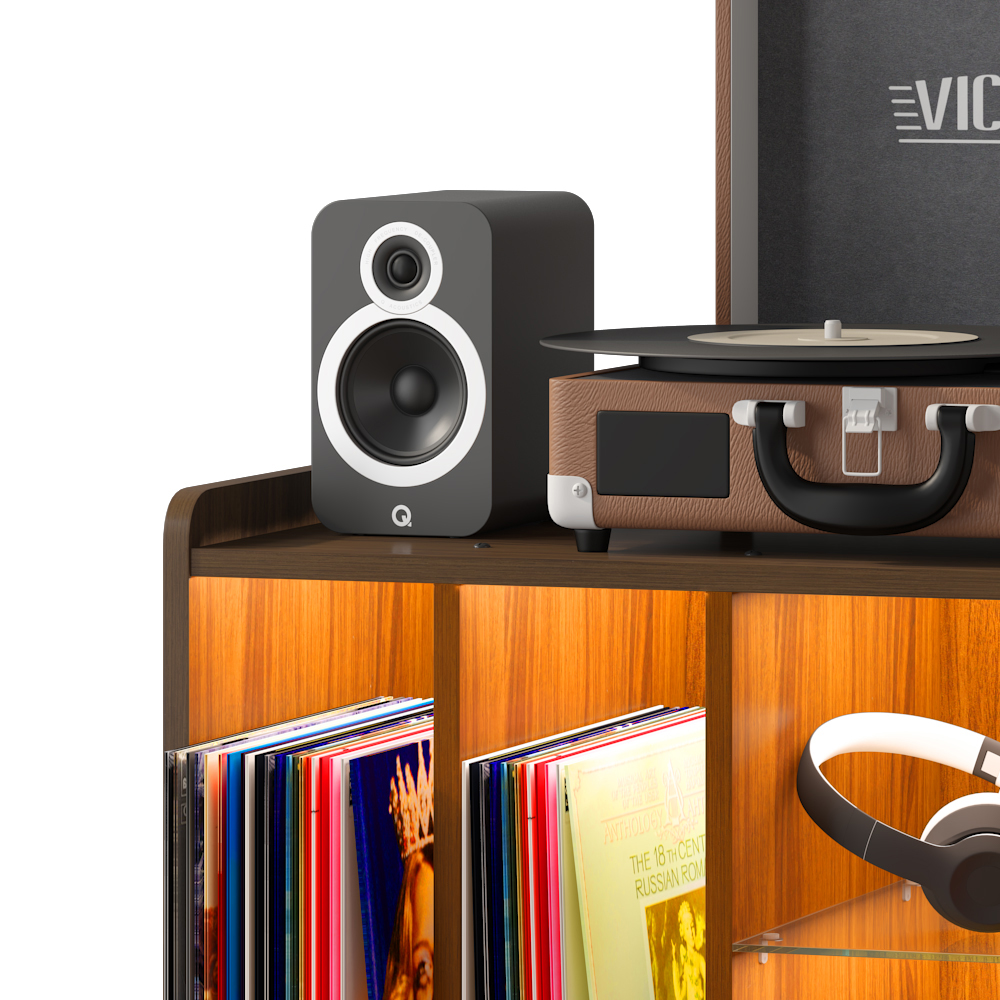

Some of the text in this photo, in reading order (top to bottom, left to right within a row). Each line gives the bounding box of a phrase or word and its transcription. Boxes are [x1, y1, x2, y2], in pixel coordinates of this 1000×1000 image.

[389, 299, 423, 311] ACOUSTICS
[391, 504, 412, 527] Q
[604, 809, 663, 845] ANTHOLOGY
[629, 851, 651, 874] THE
[635, 859, 706, 899] RUSSIAN ROM
